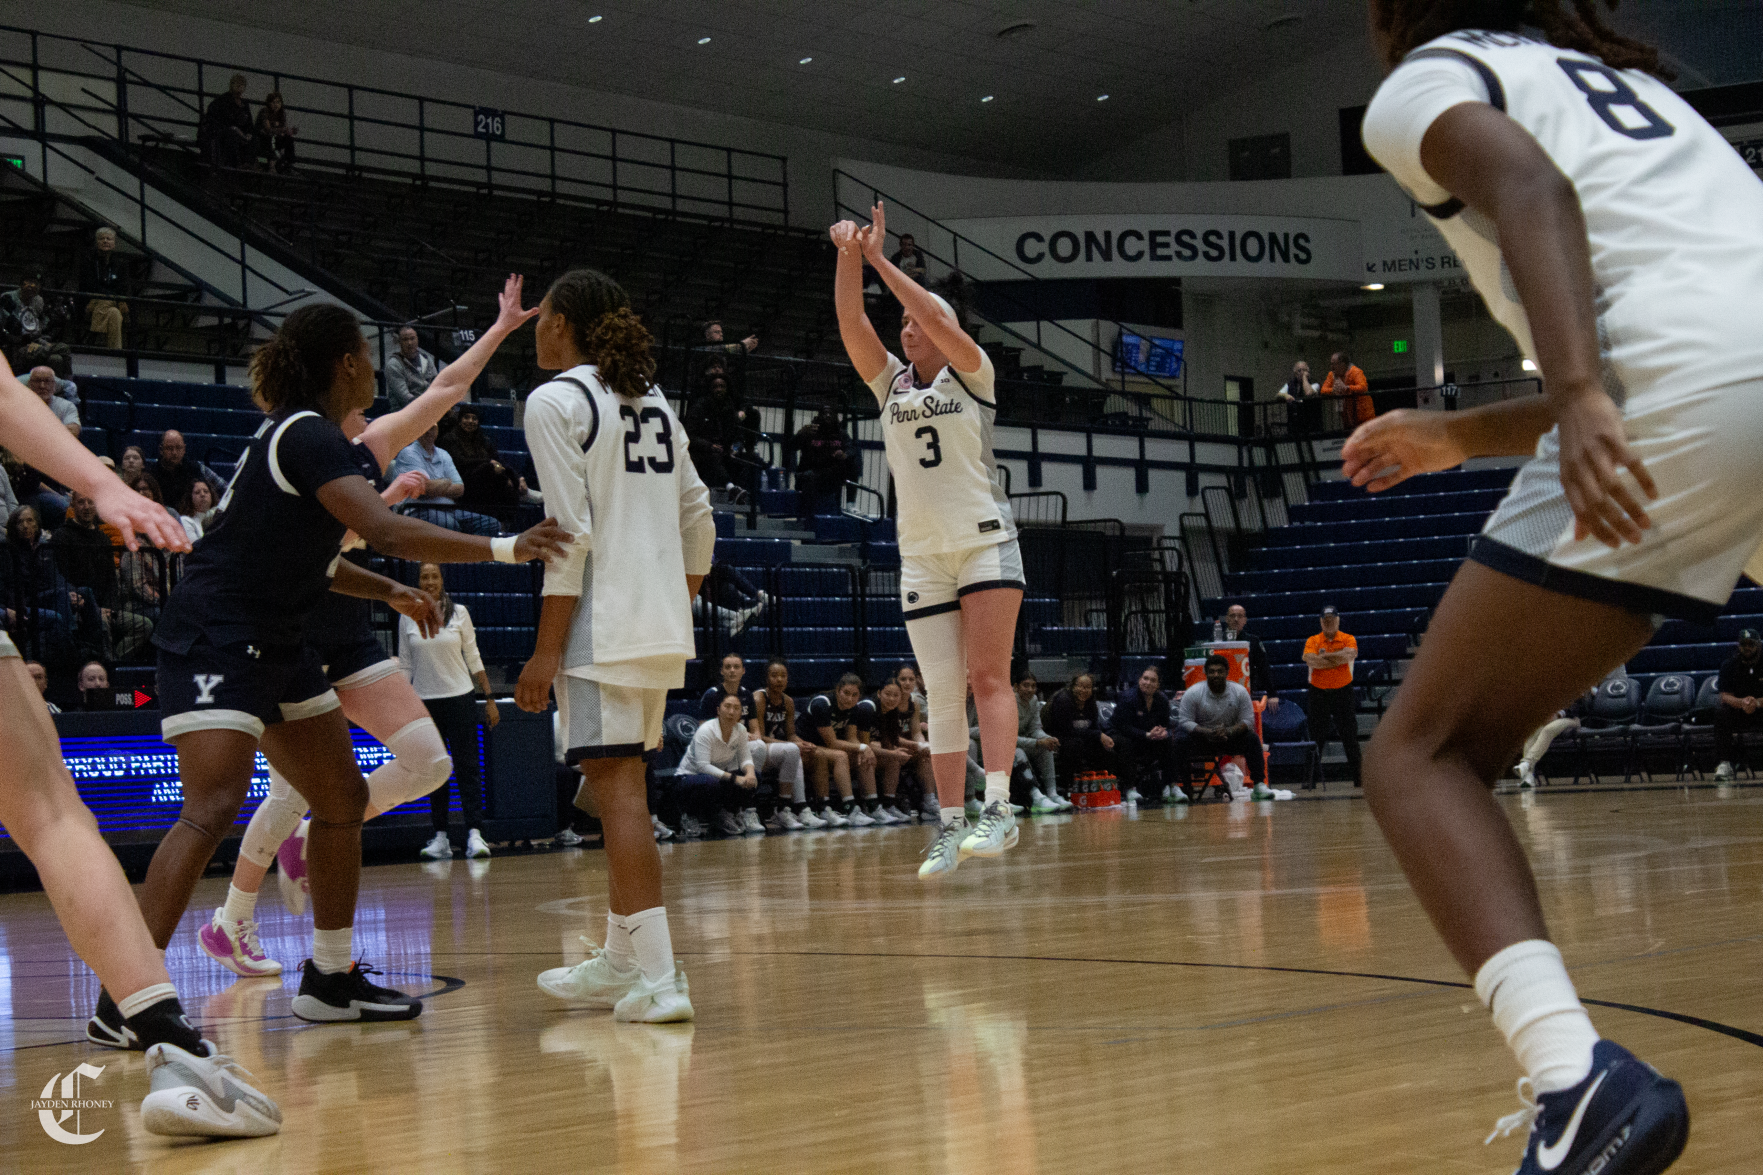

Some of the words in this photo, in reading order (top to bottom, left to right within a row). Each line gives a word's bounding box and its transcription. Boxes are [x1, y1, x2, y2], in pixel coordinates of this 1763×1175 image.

[1556, 56, 1676, 141] 8
[477, 114, 502, 135] 216
[1015, 228, 1312, 265] CONCESSIONS
[1382, 256, 1436, 273] MEN'S
[459, 329, 475, 341] 115
[1441, 386, 1457, 396] 117
[890, 402, 919, 425] Penn
[921, 395, 963, 418] State
[619, 404, 674, 474] 23
[914, 425, 942, 468] 3
[193, 673, 224, 704] Y
